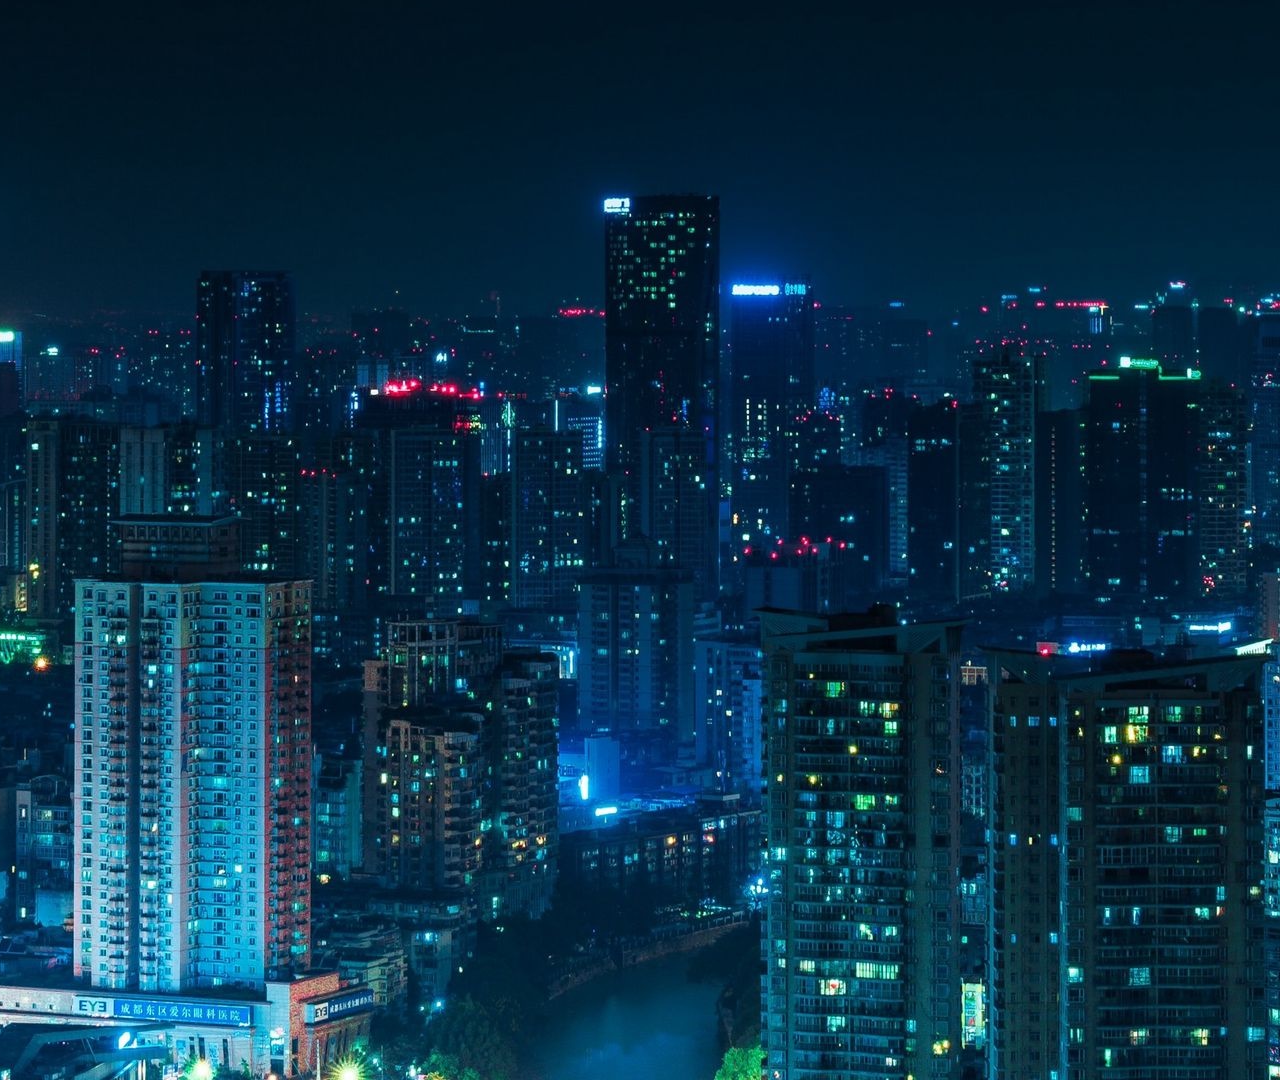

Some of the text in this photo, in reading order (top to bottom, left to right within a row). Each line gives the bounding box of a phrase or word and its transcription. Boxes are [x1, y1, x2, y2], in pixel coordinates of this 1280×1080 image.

[120, 1003, 241, 1022] 成都东区爱尔眼科医院
